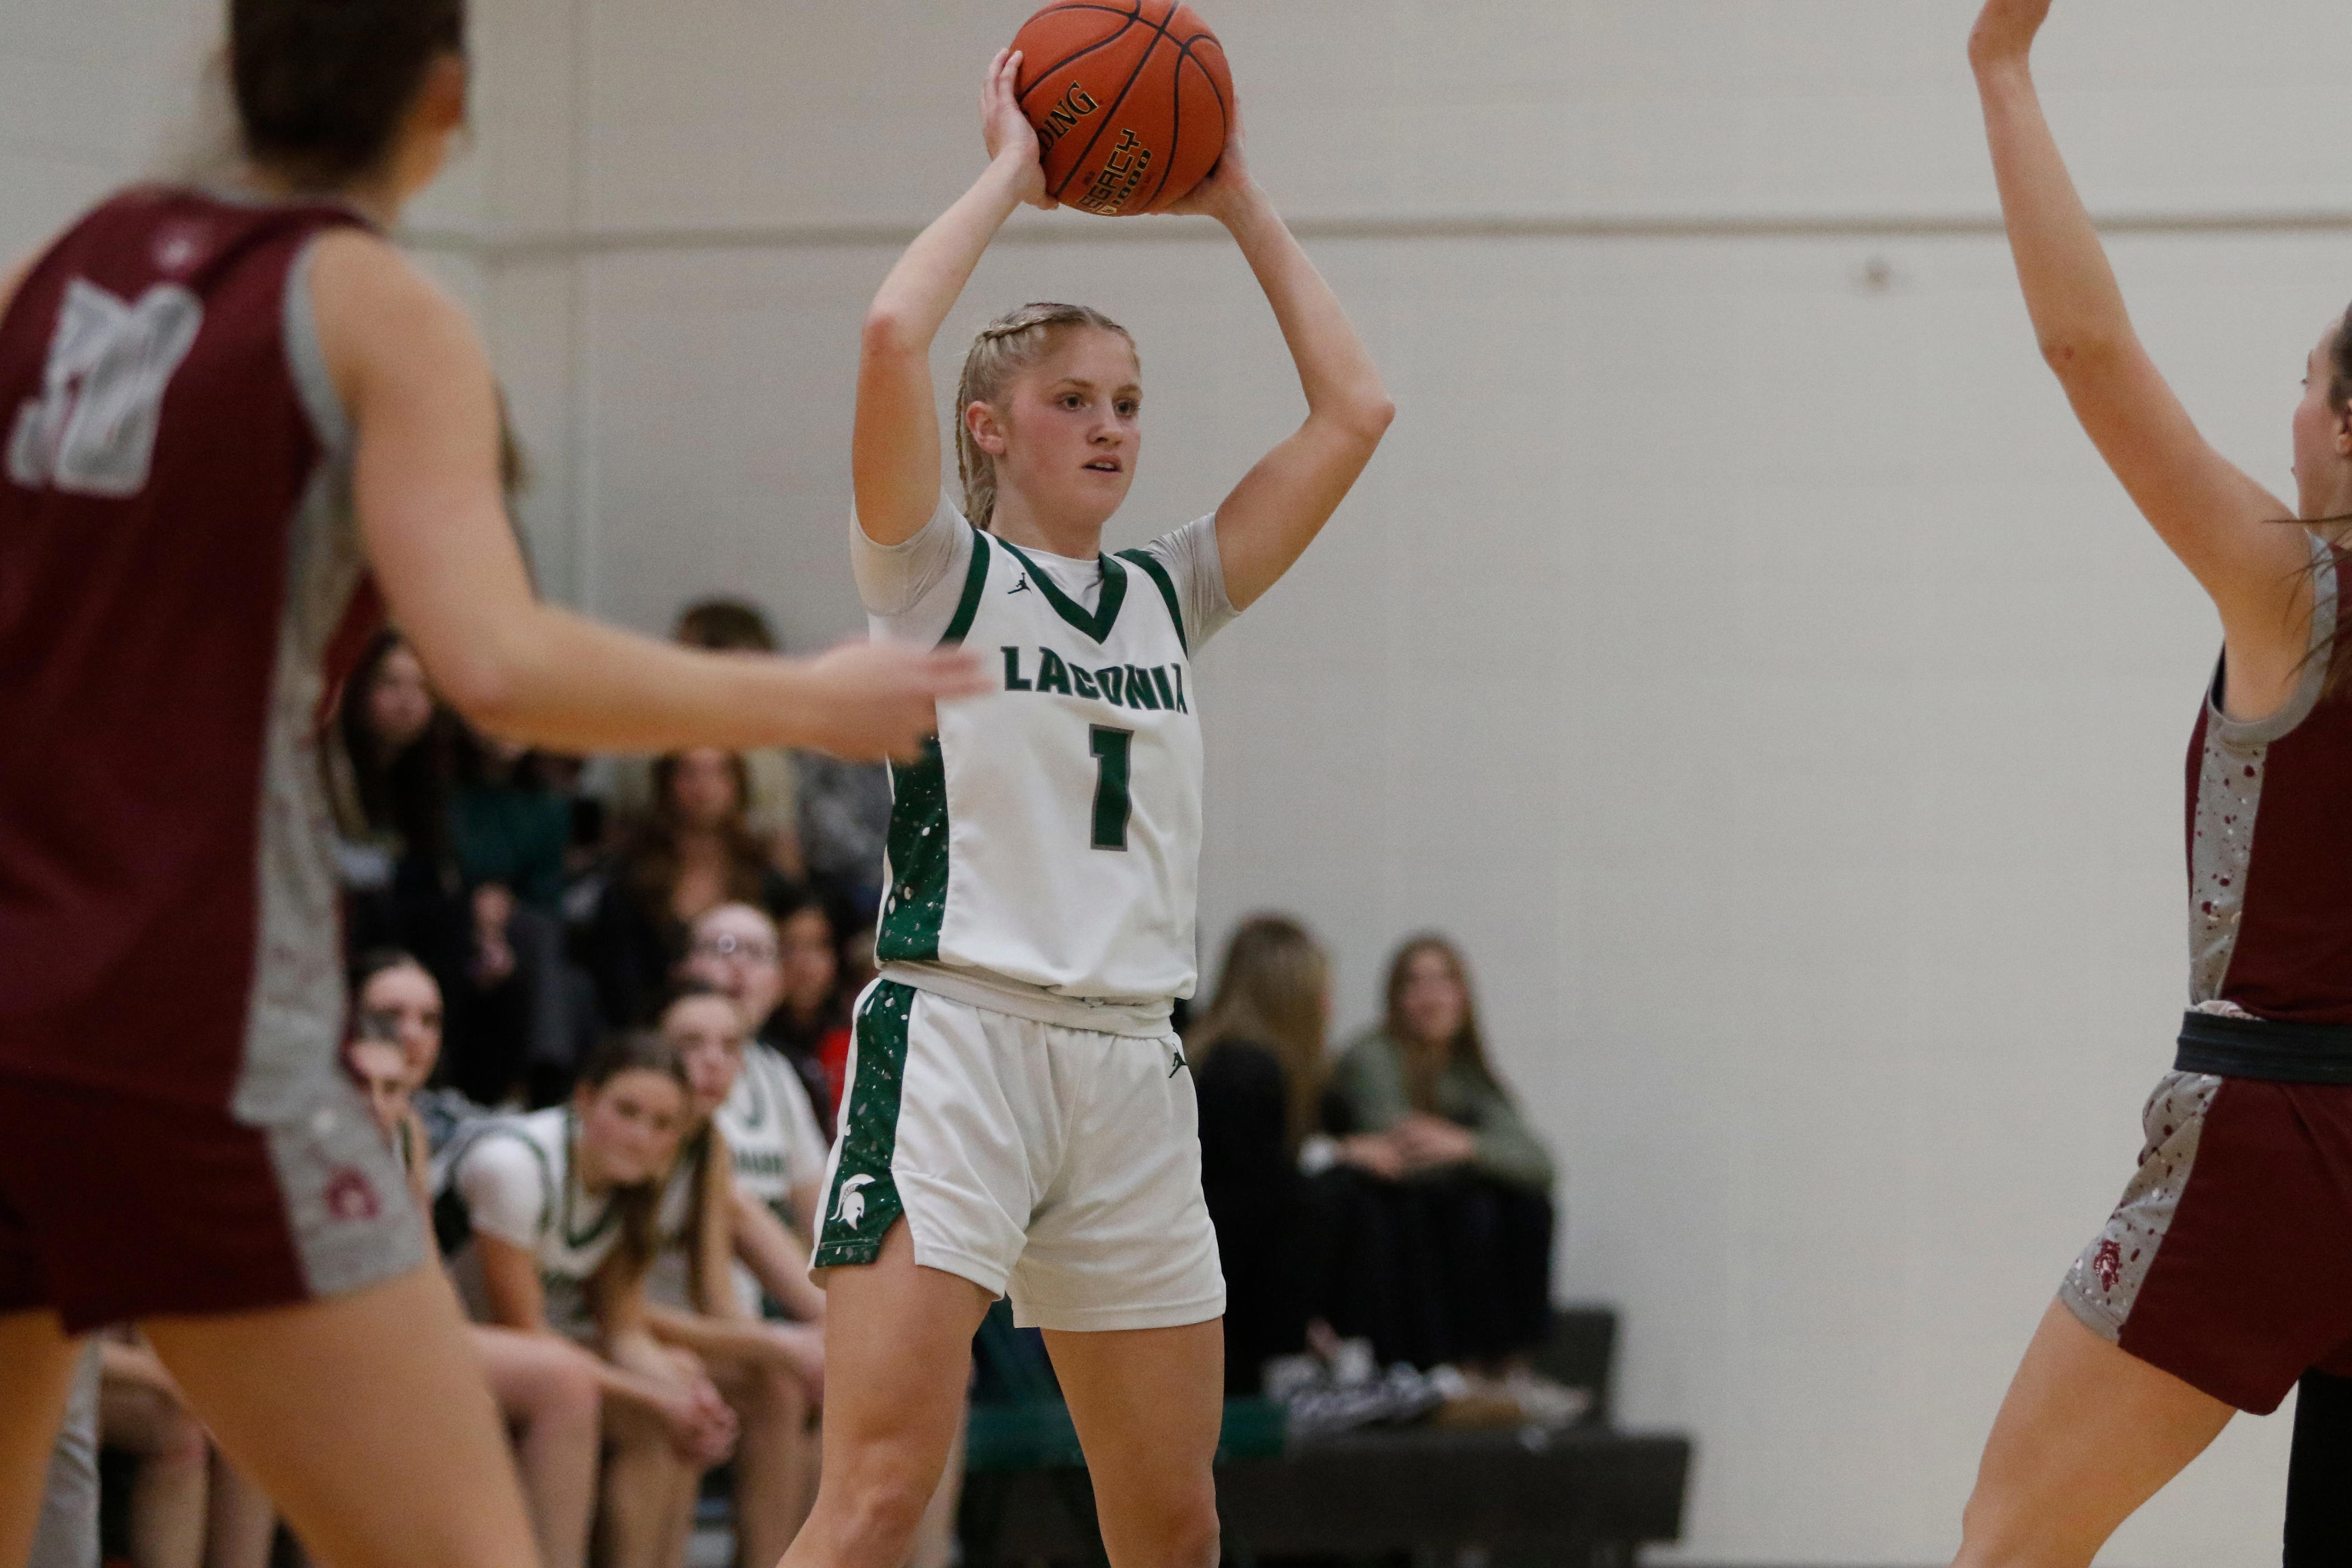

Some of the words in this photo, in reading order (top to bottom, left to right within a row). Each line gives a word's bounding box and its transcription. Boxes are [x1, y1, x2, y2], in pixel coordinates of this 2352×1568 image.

[1038, 80, 1099, 163] DING
[1077, 128, 1141, 212] EGACY
[1000, 646, 1189, 715] LACONIA
[1089, 723, 1135, 852] 1
